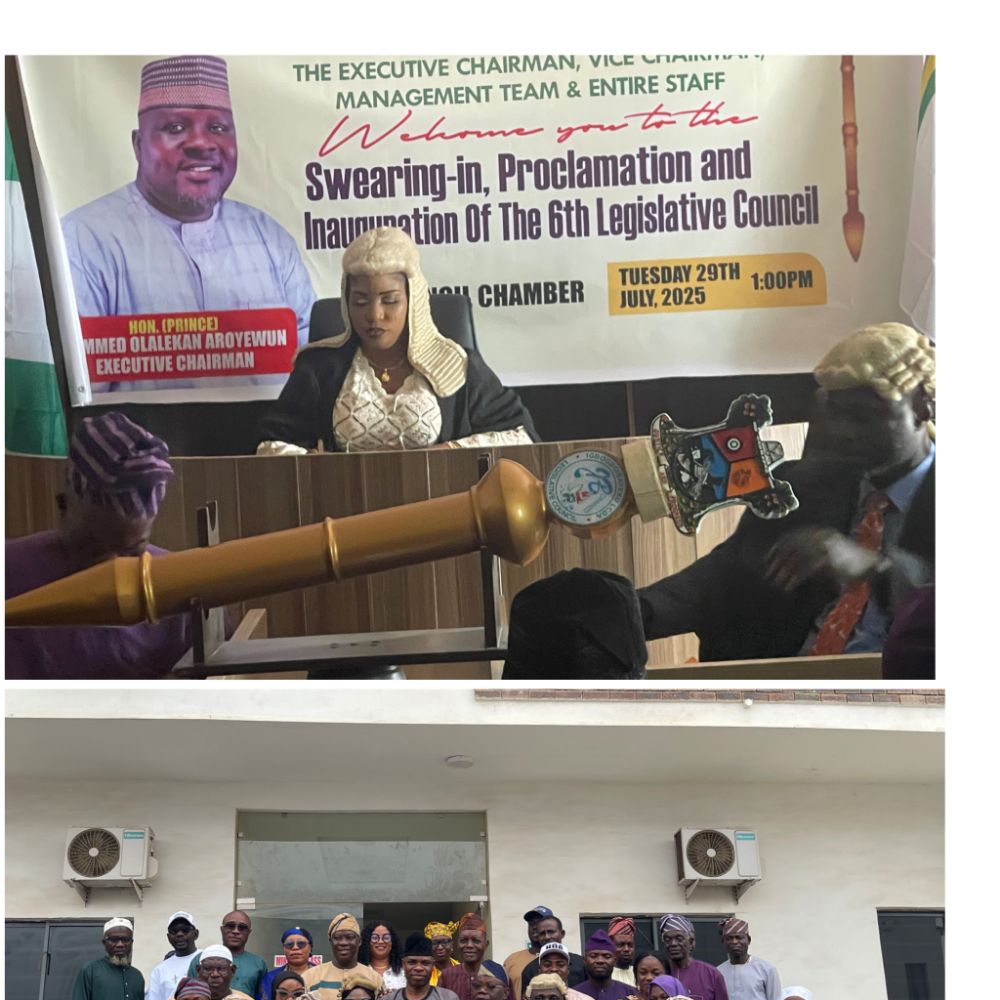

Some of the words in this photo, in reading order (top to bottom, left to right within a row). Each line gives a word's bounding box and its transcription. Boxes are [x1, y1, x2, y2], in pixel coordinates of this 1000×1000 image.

[293, 63, 331, 82] THE
[339, 59, 449, 80] EXECUTIVE
[456, 54, 581, 75] CHAIRMAN,
[589, 54, 635, 68] VICE
[336, 85, 493, 110] MANAGEMENT
[499, 82, 560, 102] TEAM
[566, 80, 582, 98] &
[589, 75, 659, 97] ENTIRE
[665, 72, 725, 93] STAFF
[557, 123, 629, 143] you
[624, 103, 676, 130] to
[671, 101, 758, 127] the
[305, 155, 490, 202] Swearing-in,
[498, 145, 692, 193] Proclamation
[700, 140, 752, 181] and
[465, 203, 491, 243] Of
[498, 202, 542, 241] The
[549, 197, 590, 239] 6th
[597, 192, 727, 241] Legislative
[733, 185, 820, 229] Council
[619, 264, 692, 286] TUESDAY
[696, 262, 740, 282] 29TH
[751, 270, 813, 291] 1:00PM
[478, 280, 584, 308] CHAMBER
[619, 289, 658, 309] JULY,
[661, 286, 706, 307] 2025
[128, 319, 160, 335] HON.
[161, 316, 219, 333] (PRINCE)
[130, 333, 202, 354] OLALEKAN
[205, 329, 287, 349] AROYEWUN
[96, 356, 172, 375] EXECUTIVE
[176, 352, 255, 372] CHAIRMAN
